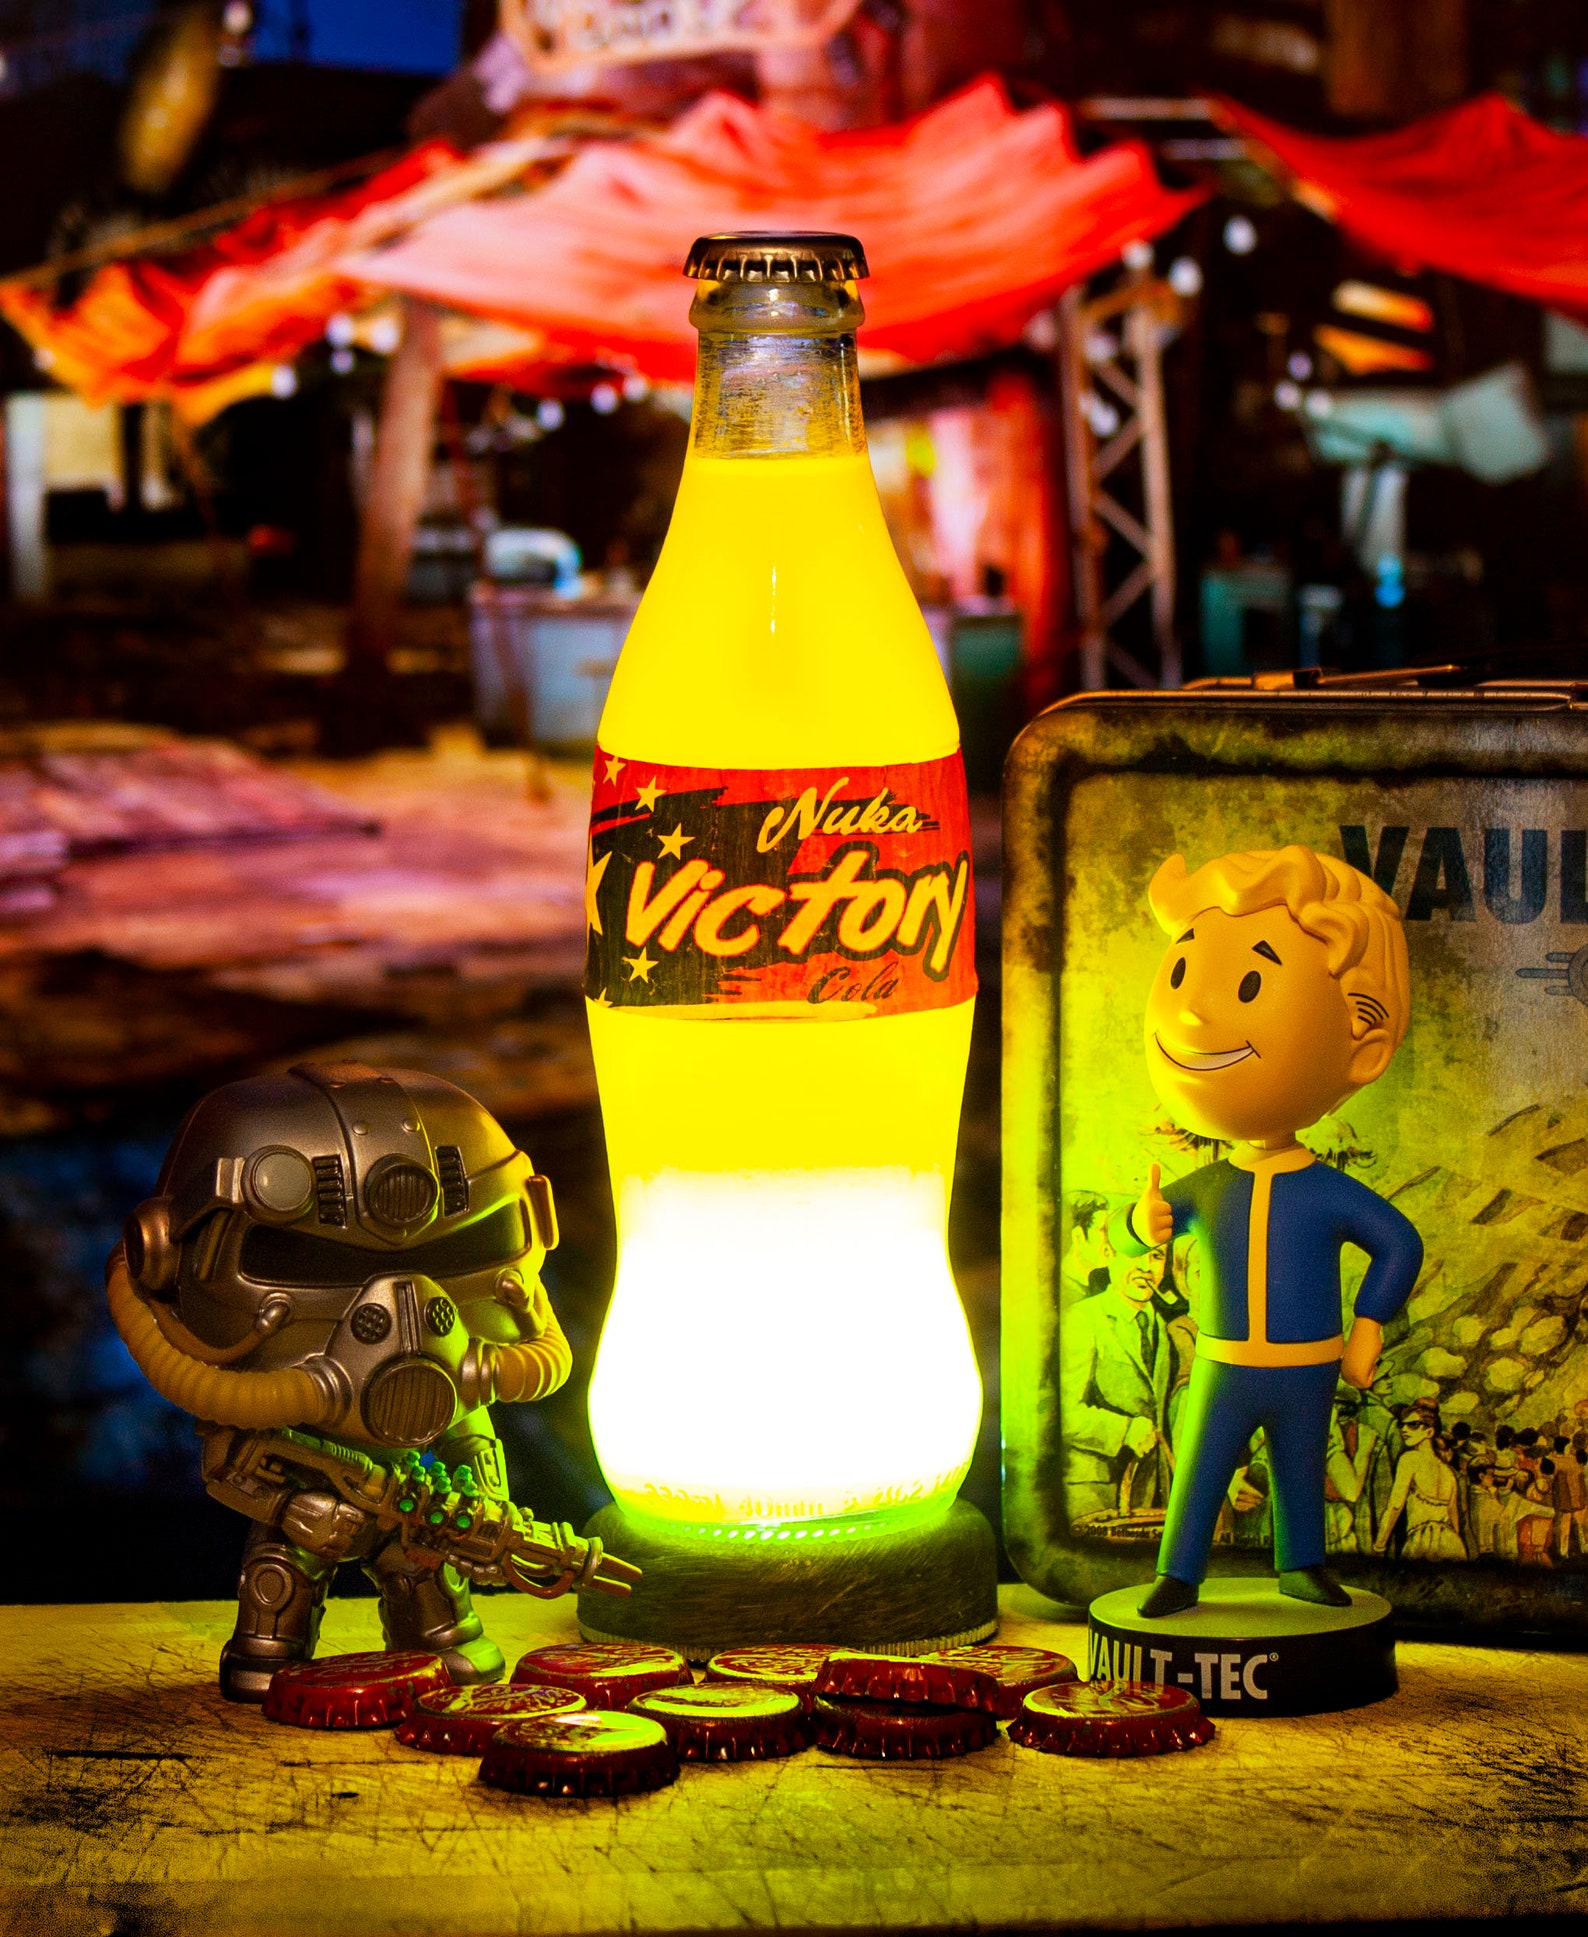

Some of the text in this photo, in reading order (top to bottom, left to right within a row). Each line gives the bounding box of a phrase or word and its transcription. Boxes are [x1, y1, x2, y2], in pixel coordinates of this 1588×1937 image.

[757, 777, 924, 853] Nuka
[625, 849, 969, 973] Victory
[807, 961, 900, 1004] Cola
[1110, 1526, 1151, 1539] Bethesda
